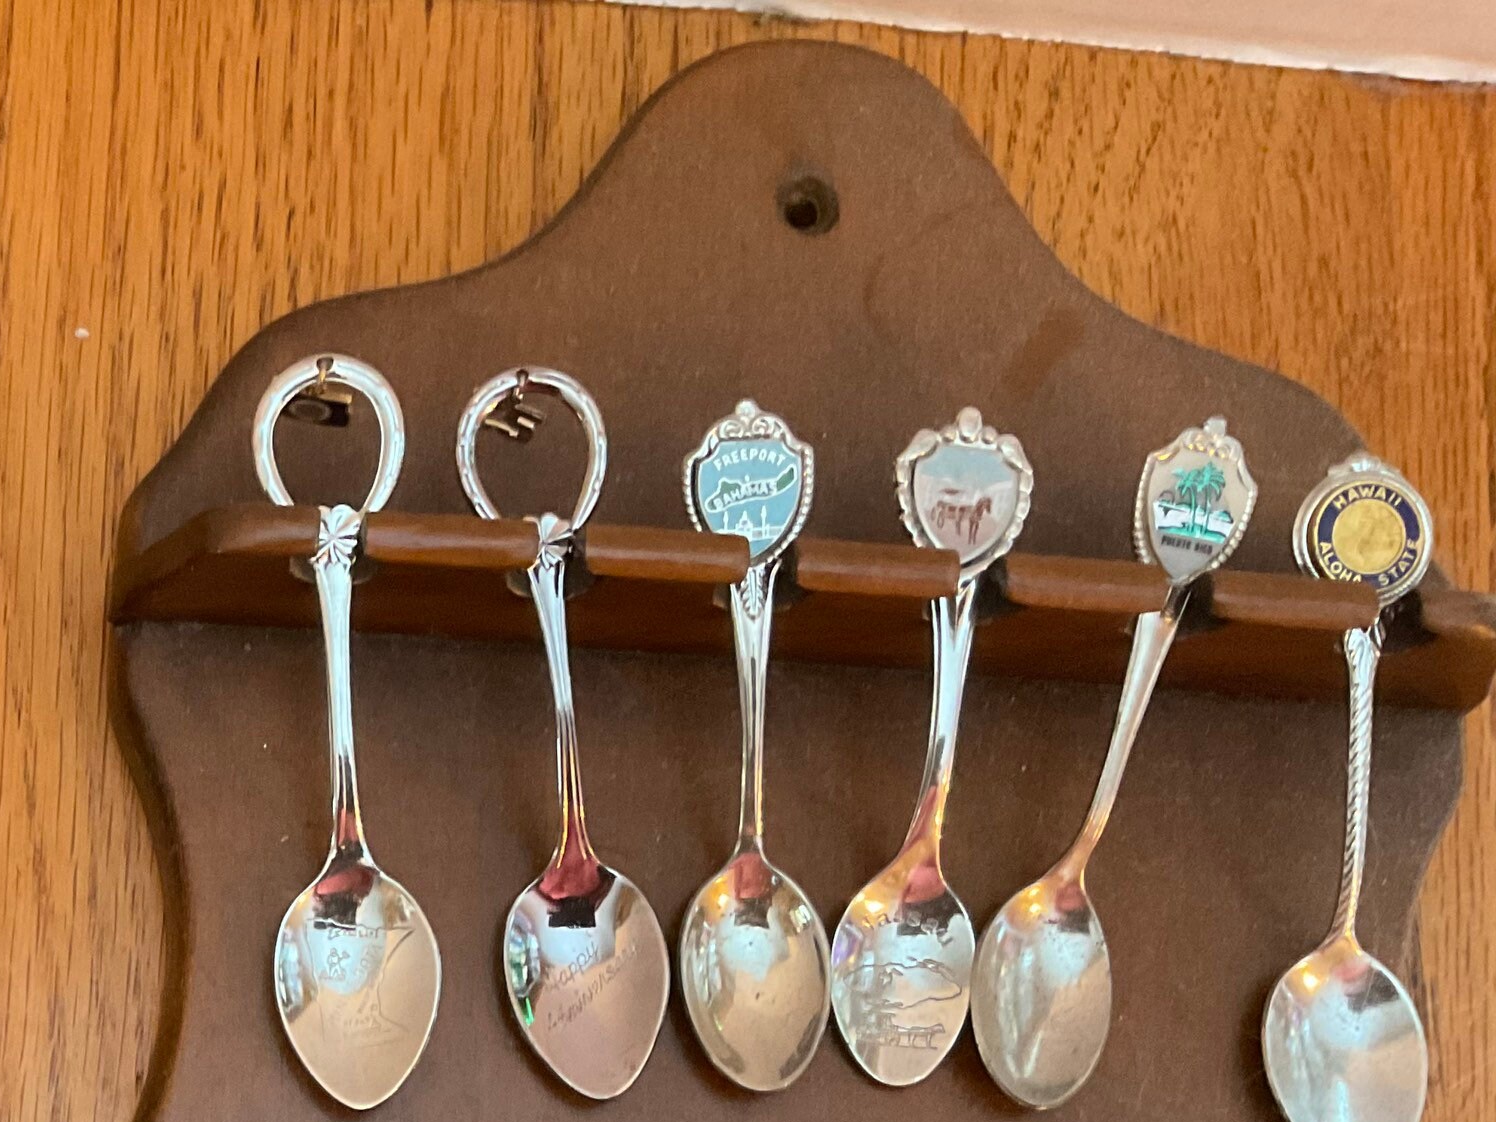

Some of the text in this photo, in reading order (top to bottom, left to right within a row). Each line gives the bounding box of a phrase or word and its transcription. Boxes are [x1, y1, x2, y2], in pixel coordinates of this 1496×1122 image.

[713, 448, 786, 471] FREEPORT
[714, 479, 778, 508] BAHAMAS
[1332, 485, 1402, 509] HAWAII
[1160, 534, 1192, 551] PUERTO
[1319, 538, 1419, 586] ALOHA STATE
